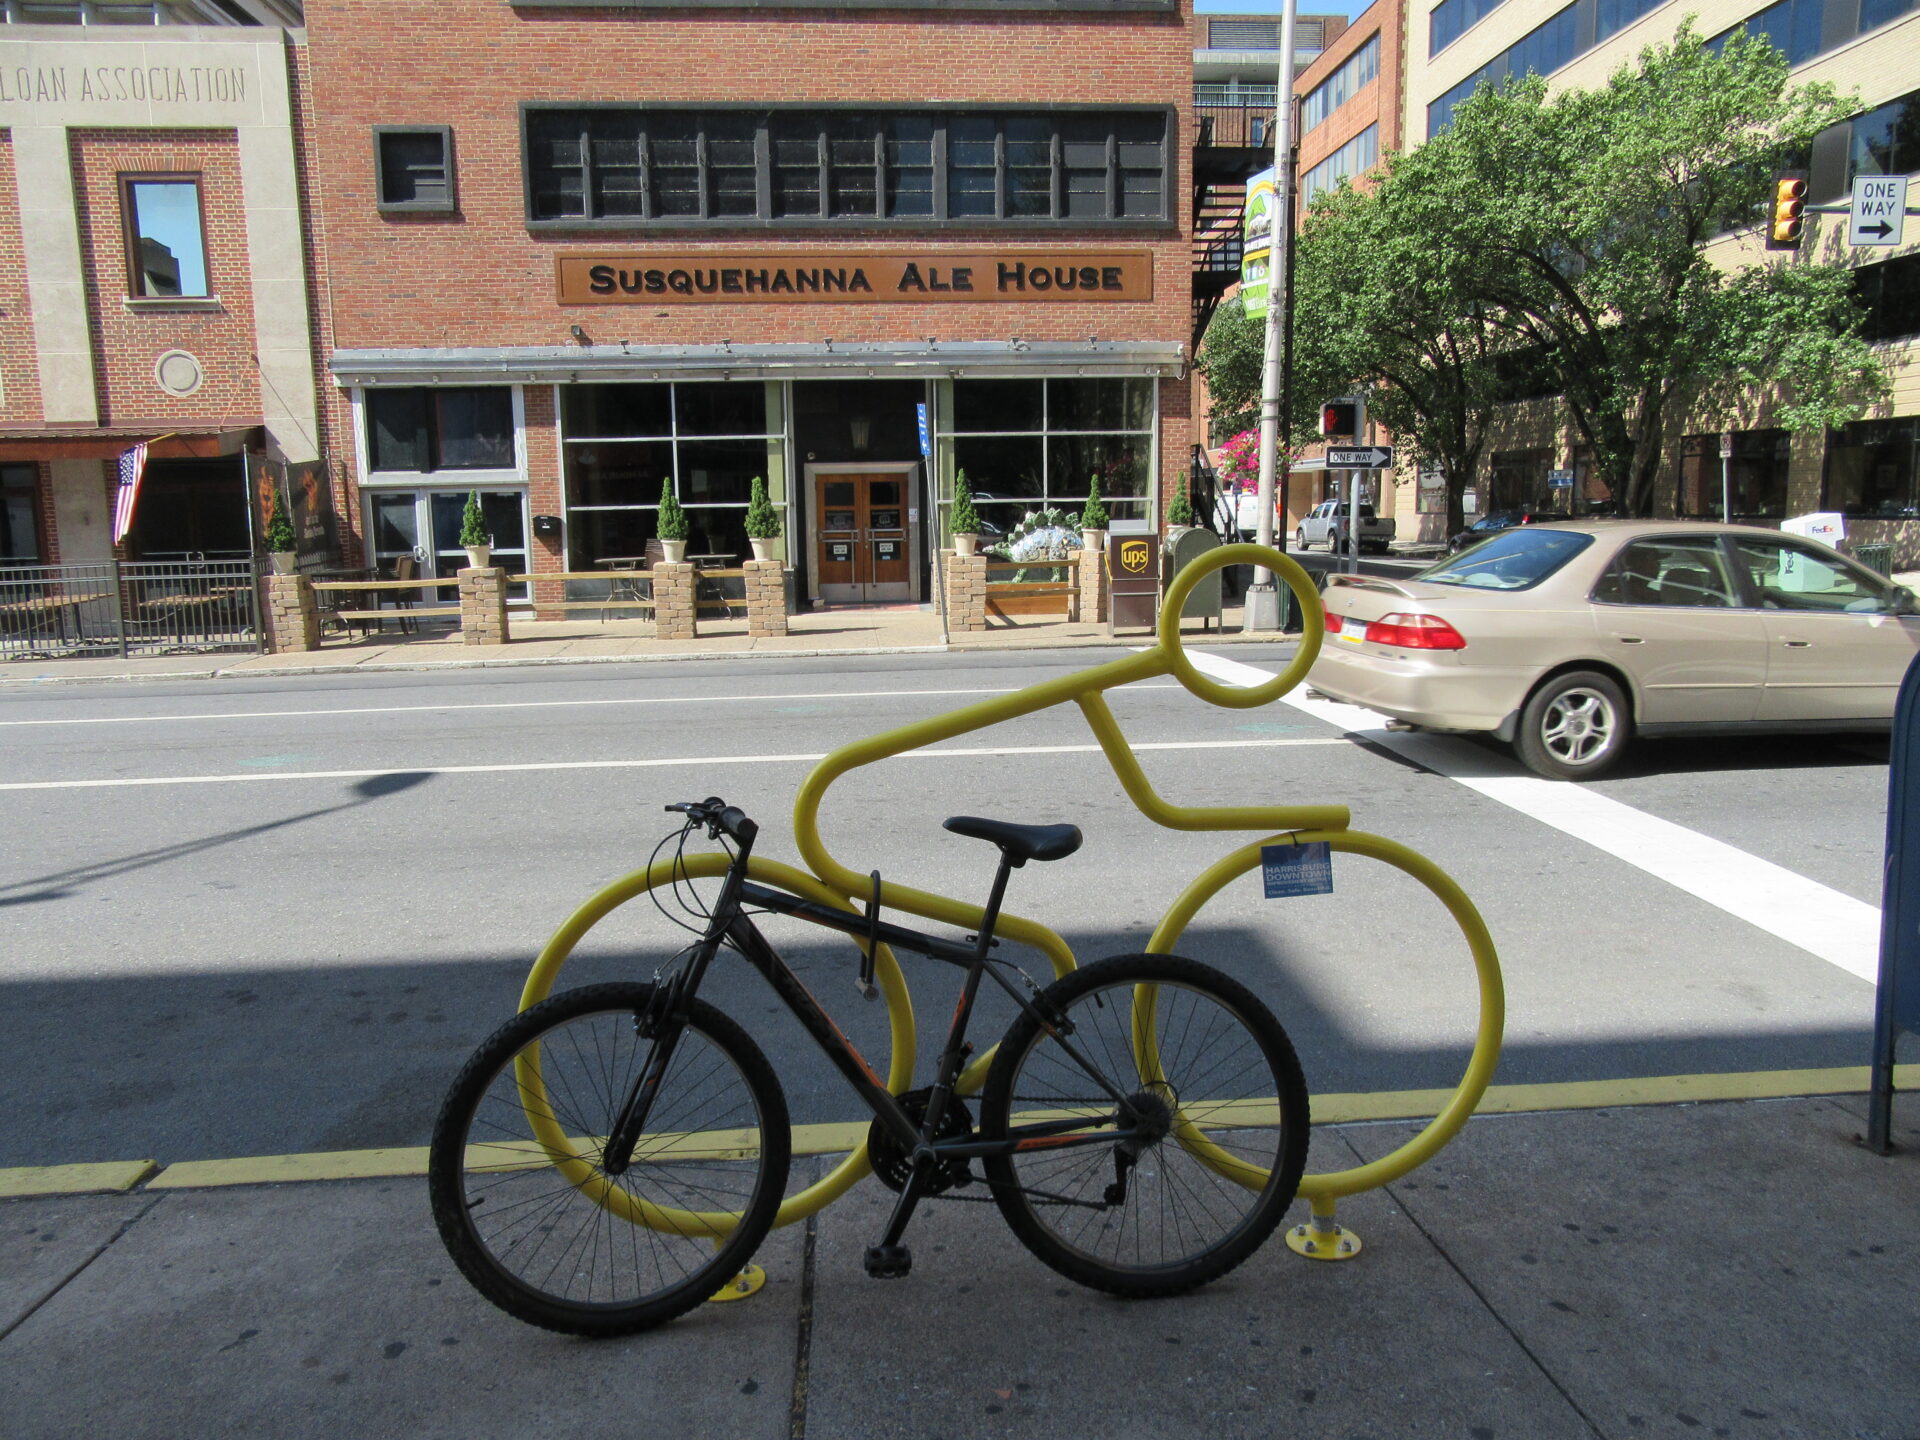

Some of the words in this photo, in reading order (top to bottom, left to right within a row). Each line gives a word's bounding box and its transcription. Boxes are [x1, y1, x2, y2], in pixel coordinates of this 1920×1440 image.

[0, 67, 67, 102] LOAN
[80, 66, 247, 102] ASSOCIATION
[1864, 183, 1896, 197] ONE
[1861, 201, 1896, 216] WAY
[897, 262, 973, 294] ALE
[996, 262, 1123, 292] HOUSE
[1333, 453, 1351, 462] ONE
[1355, 453, 1371, 462] WAY
[1811, 525, 1836, 534] FedEx
[1124, 551, 1146, 567] ups
[1266, 870, 1331, 882] DOWNTOWN
